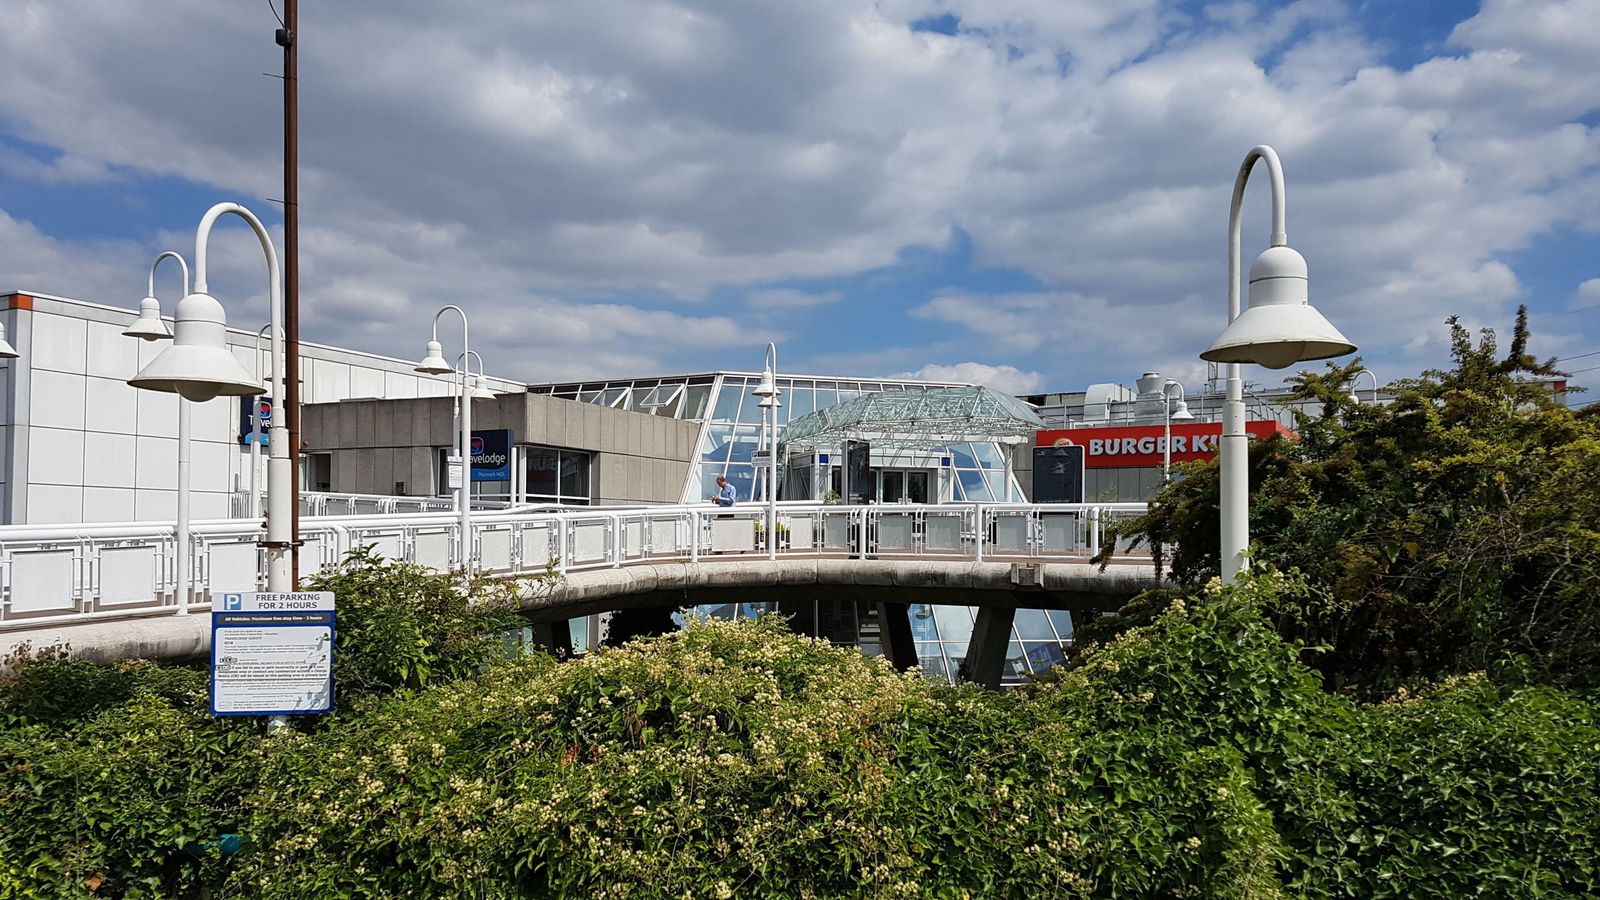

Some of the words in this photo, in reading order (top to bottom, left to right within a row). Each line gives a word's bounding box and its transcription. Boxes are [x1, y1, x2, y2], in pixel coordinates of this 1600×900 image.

[1089, 436, 1187, 456] BURGER
[470, 452, 506, 466] avelodge
[226, 594, 240, 610] P
[280, 593, 320, 601] PARKING
[286, 601, 317, 609] HOURS
